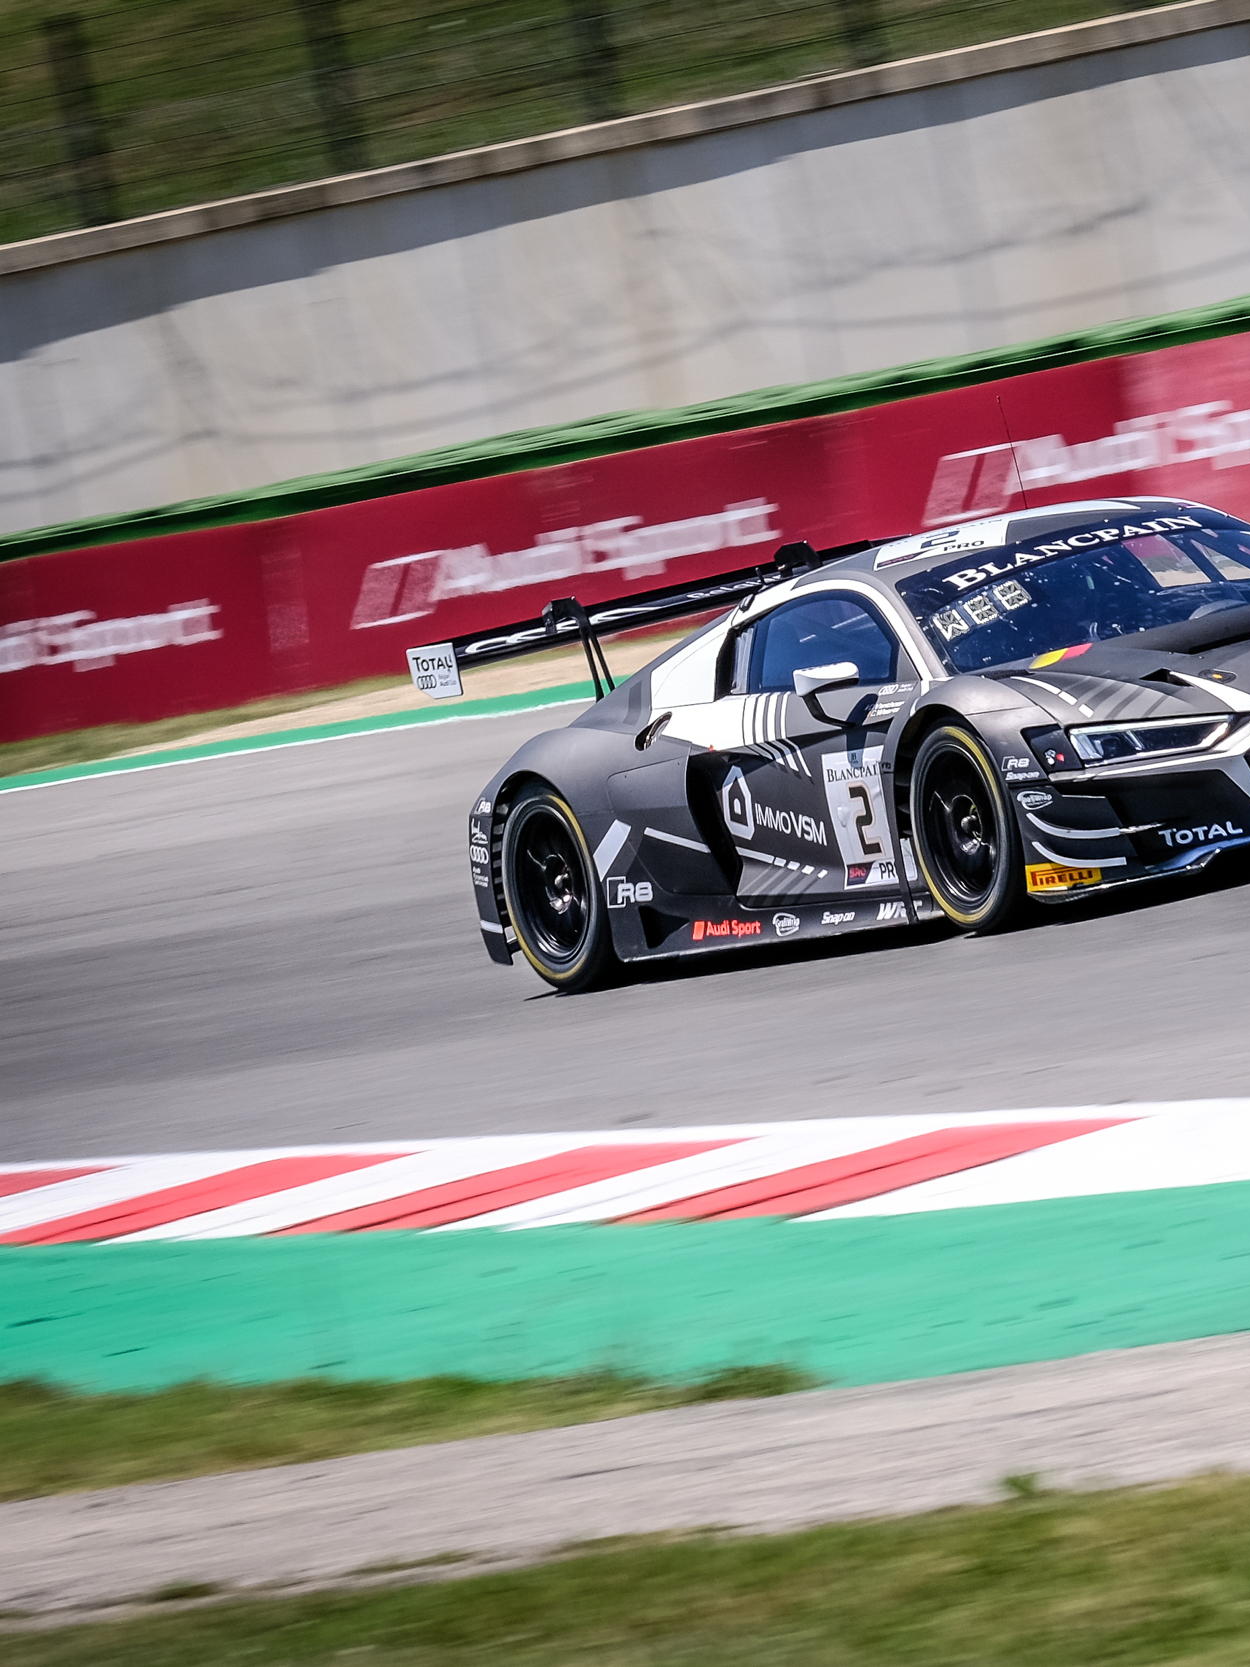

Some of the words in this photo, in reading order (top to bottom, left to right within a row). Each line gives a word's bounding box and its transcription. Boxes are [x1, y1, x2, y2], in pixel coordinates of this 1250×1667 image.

[1005, 415, 1166, 495] Audi
[430, 527, 582, 602] Audi
[581, 497, 782, 581] Sport
[942, 516, 1203, 591] BLANCPAIN
[943, 540, 985, 552] PRO
[40, 597, 224, 673] Sport
[412, 655, 454, 673] TOTAL
[827, 761, 880, 783] BLANCPAI
[847, 783, 885, 857] 2
[1158, 820, 1244, 848] TOTAL
[878, 861, 897, 880] PR
[1030, 867, 1094, 887] PIRELLI
[617, 881, 654, 905] R8
[706, 920, 730, 937] Audi
[731, 919, 762, 938] Sport
